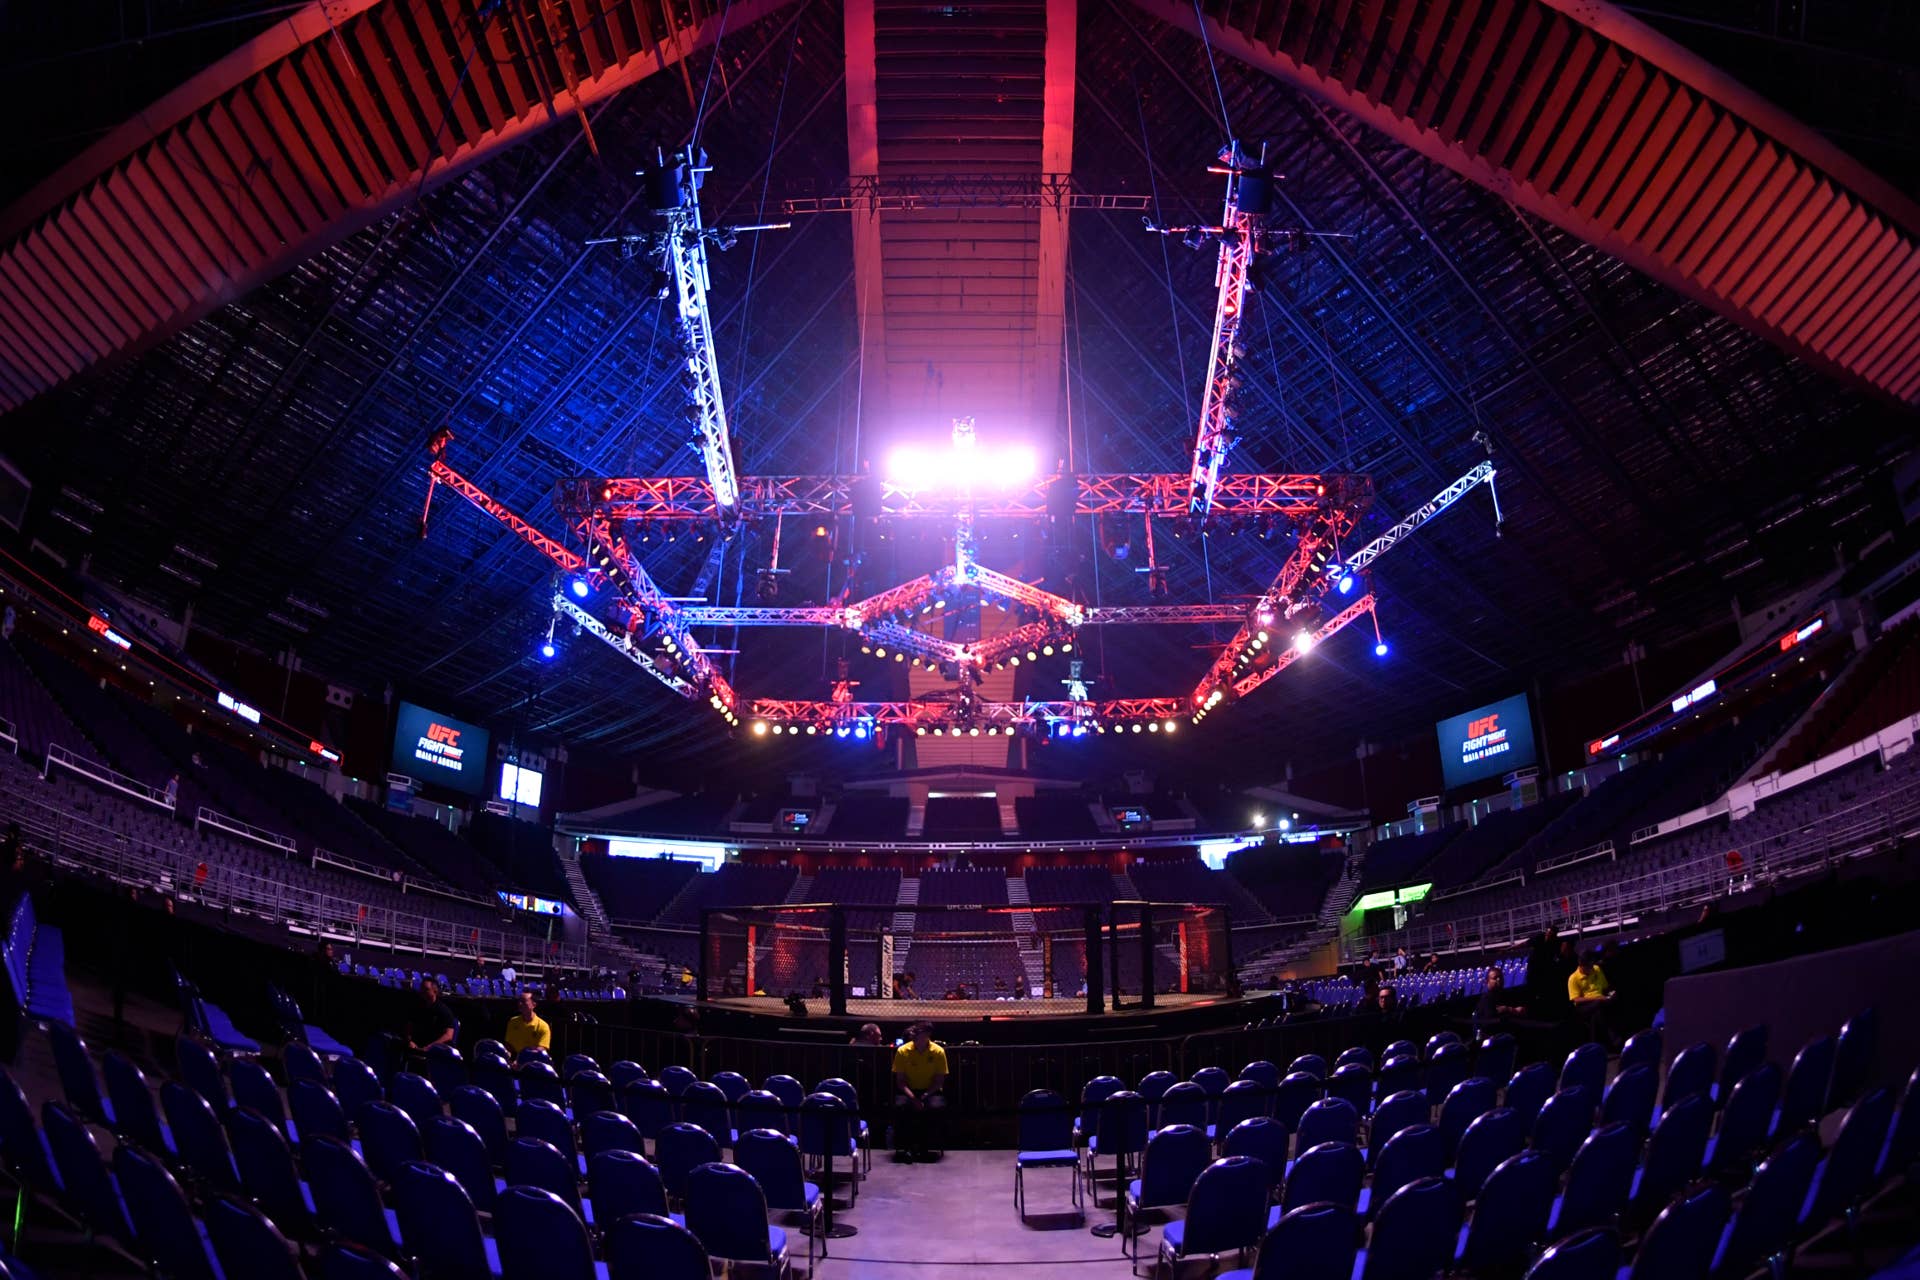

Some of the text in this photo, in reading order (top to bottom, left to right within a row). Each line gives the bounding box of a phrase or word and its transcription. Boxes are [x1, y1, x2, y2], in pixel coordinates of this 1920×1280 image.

[88, 616, 109, 636] UFC
[1781, 630, 1798, 650] UFC
[427, 723, 461, 747] UFC
[1468, 714, 1499, 739] UFC
[418, 737, 446, 754] FIGHT
[1462, 735, 1488, 753] FIGHT
